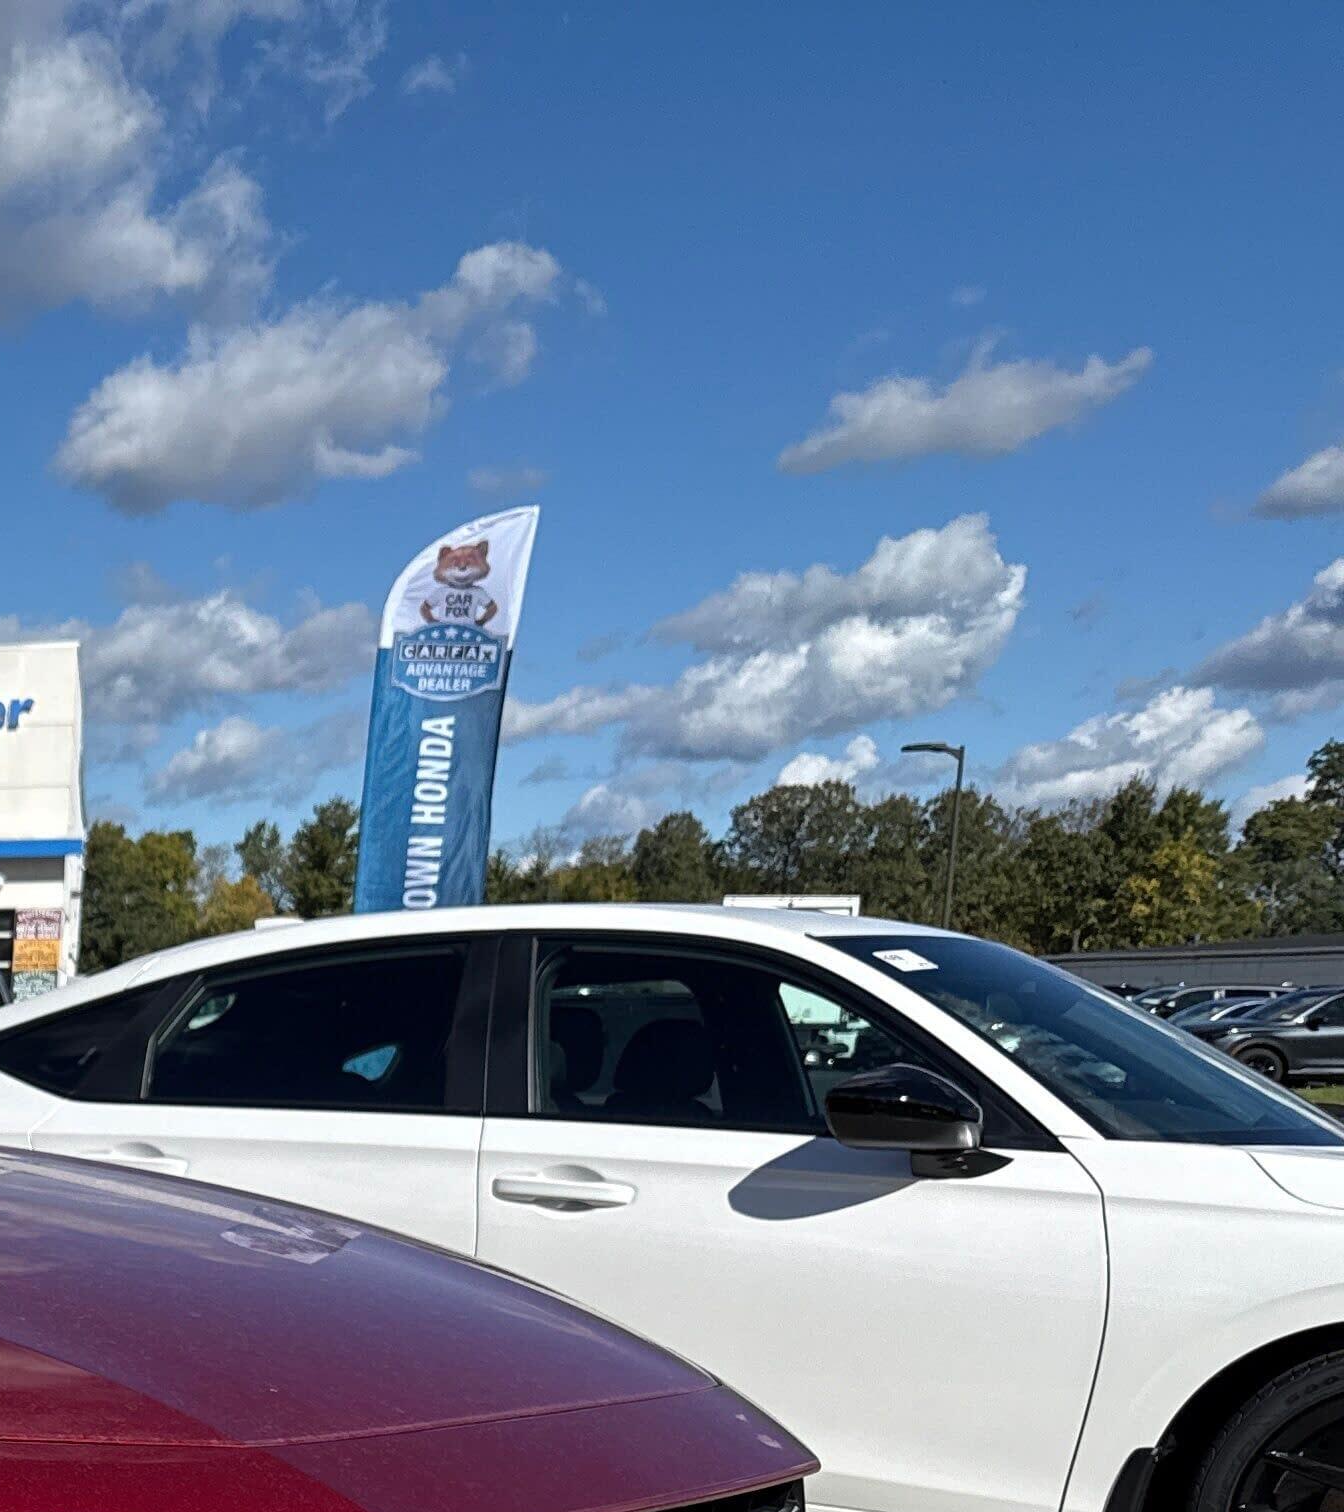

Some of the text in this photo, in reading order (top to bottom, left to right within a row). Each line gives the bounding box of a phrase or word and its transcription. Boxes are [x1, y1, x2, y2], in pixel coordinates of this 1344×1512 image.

[445, 594, 473, 606] CAR
[445, 606, 471, 618] FOX
[401, 644, 496, 661] CARFAX
[406, 662, 487, 677] ADVANTAGE
[417, 677, 471, 691] DEALER
[402, 715, 456, 910] OWN HONDA
